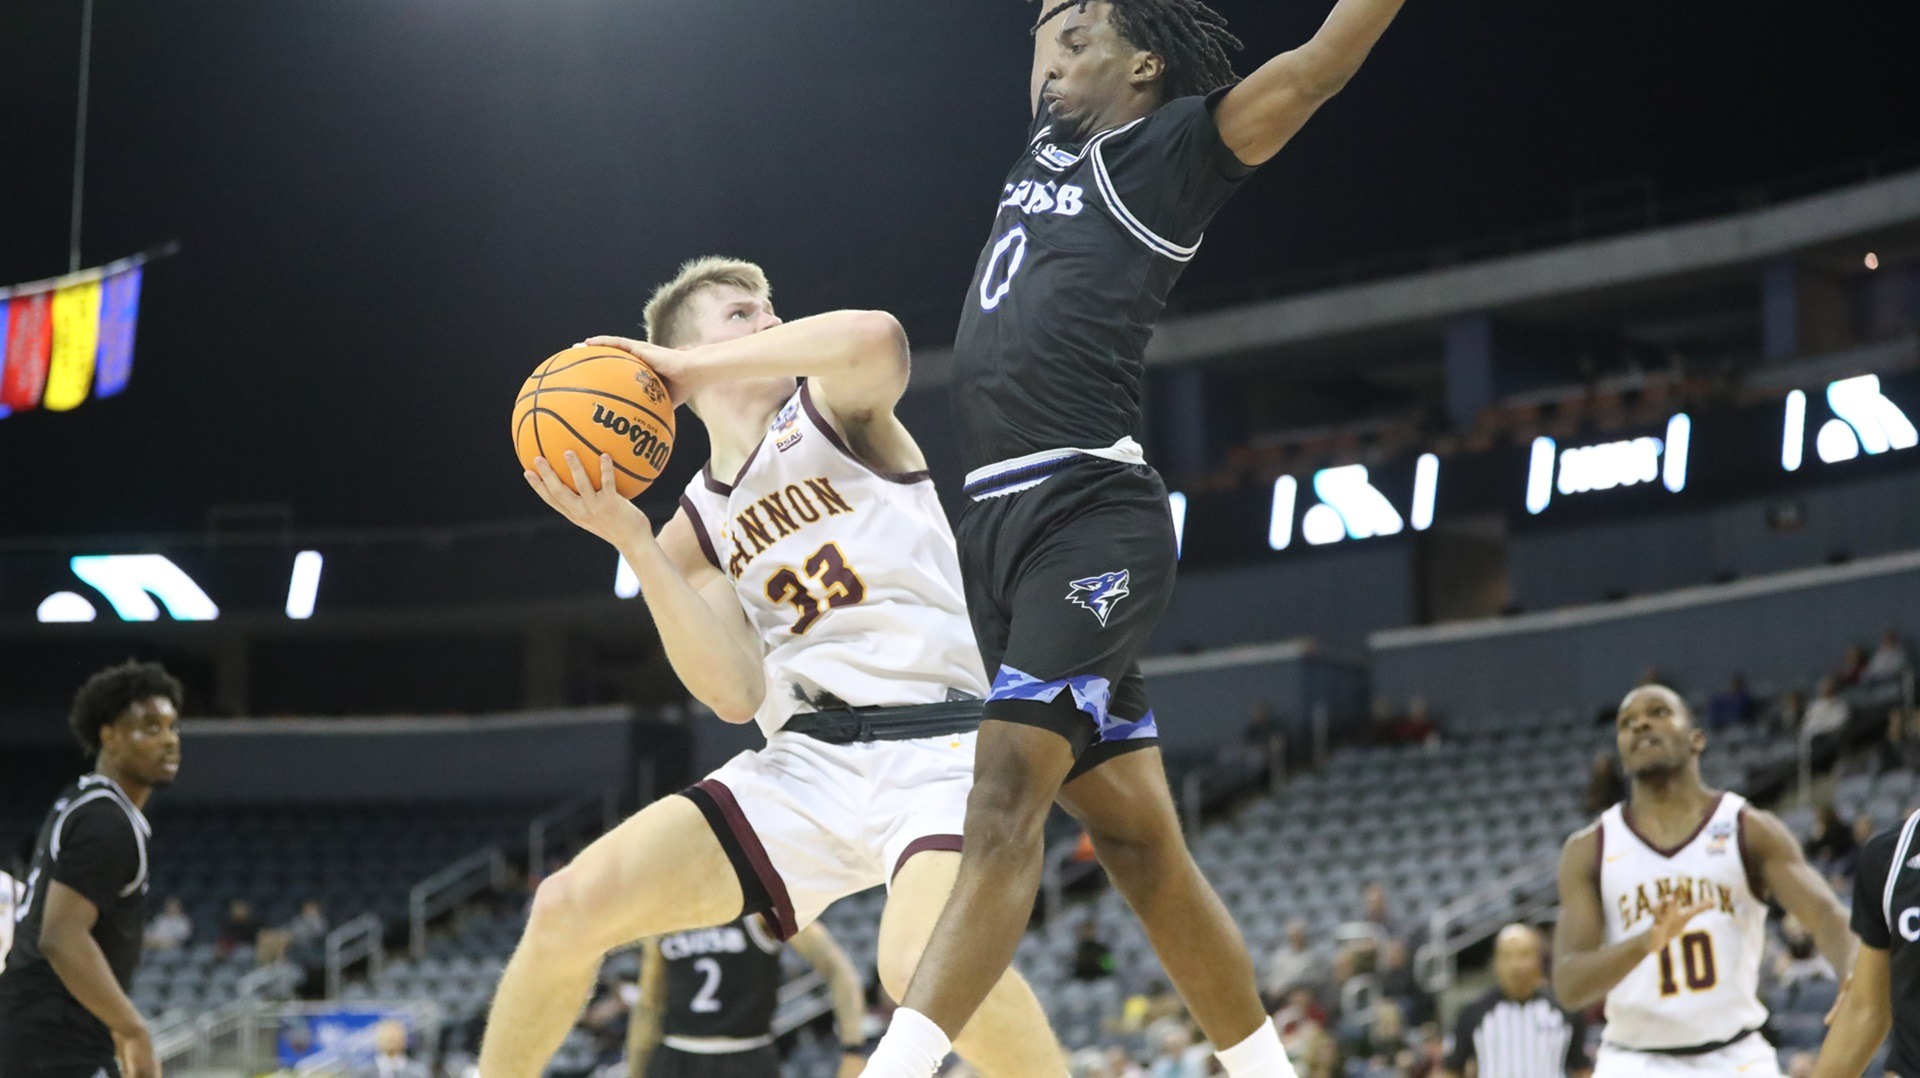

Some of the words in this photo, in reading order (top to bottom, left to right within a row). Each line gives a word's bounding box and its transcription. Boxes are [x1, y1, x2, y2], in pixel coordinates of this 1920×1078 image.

[996, 179, 1084, 217] USB
[980, 222, 1028, 313] 0
[592, 403, 671, 472] Wilson
[728, 476, 855, 580] ANNON
[764, 541, 867, 635] 33
[690, 957, 722, 1013] 2
[1659, 929, 1717, 997] 10
